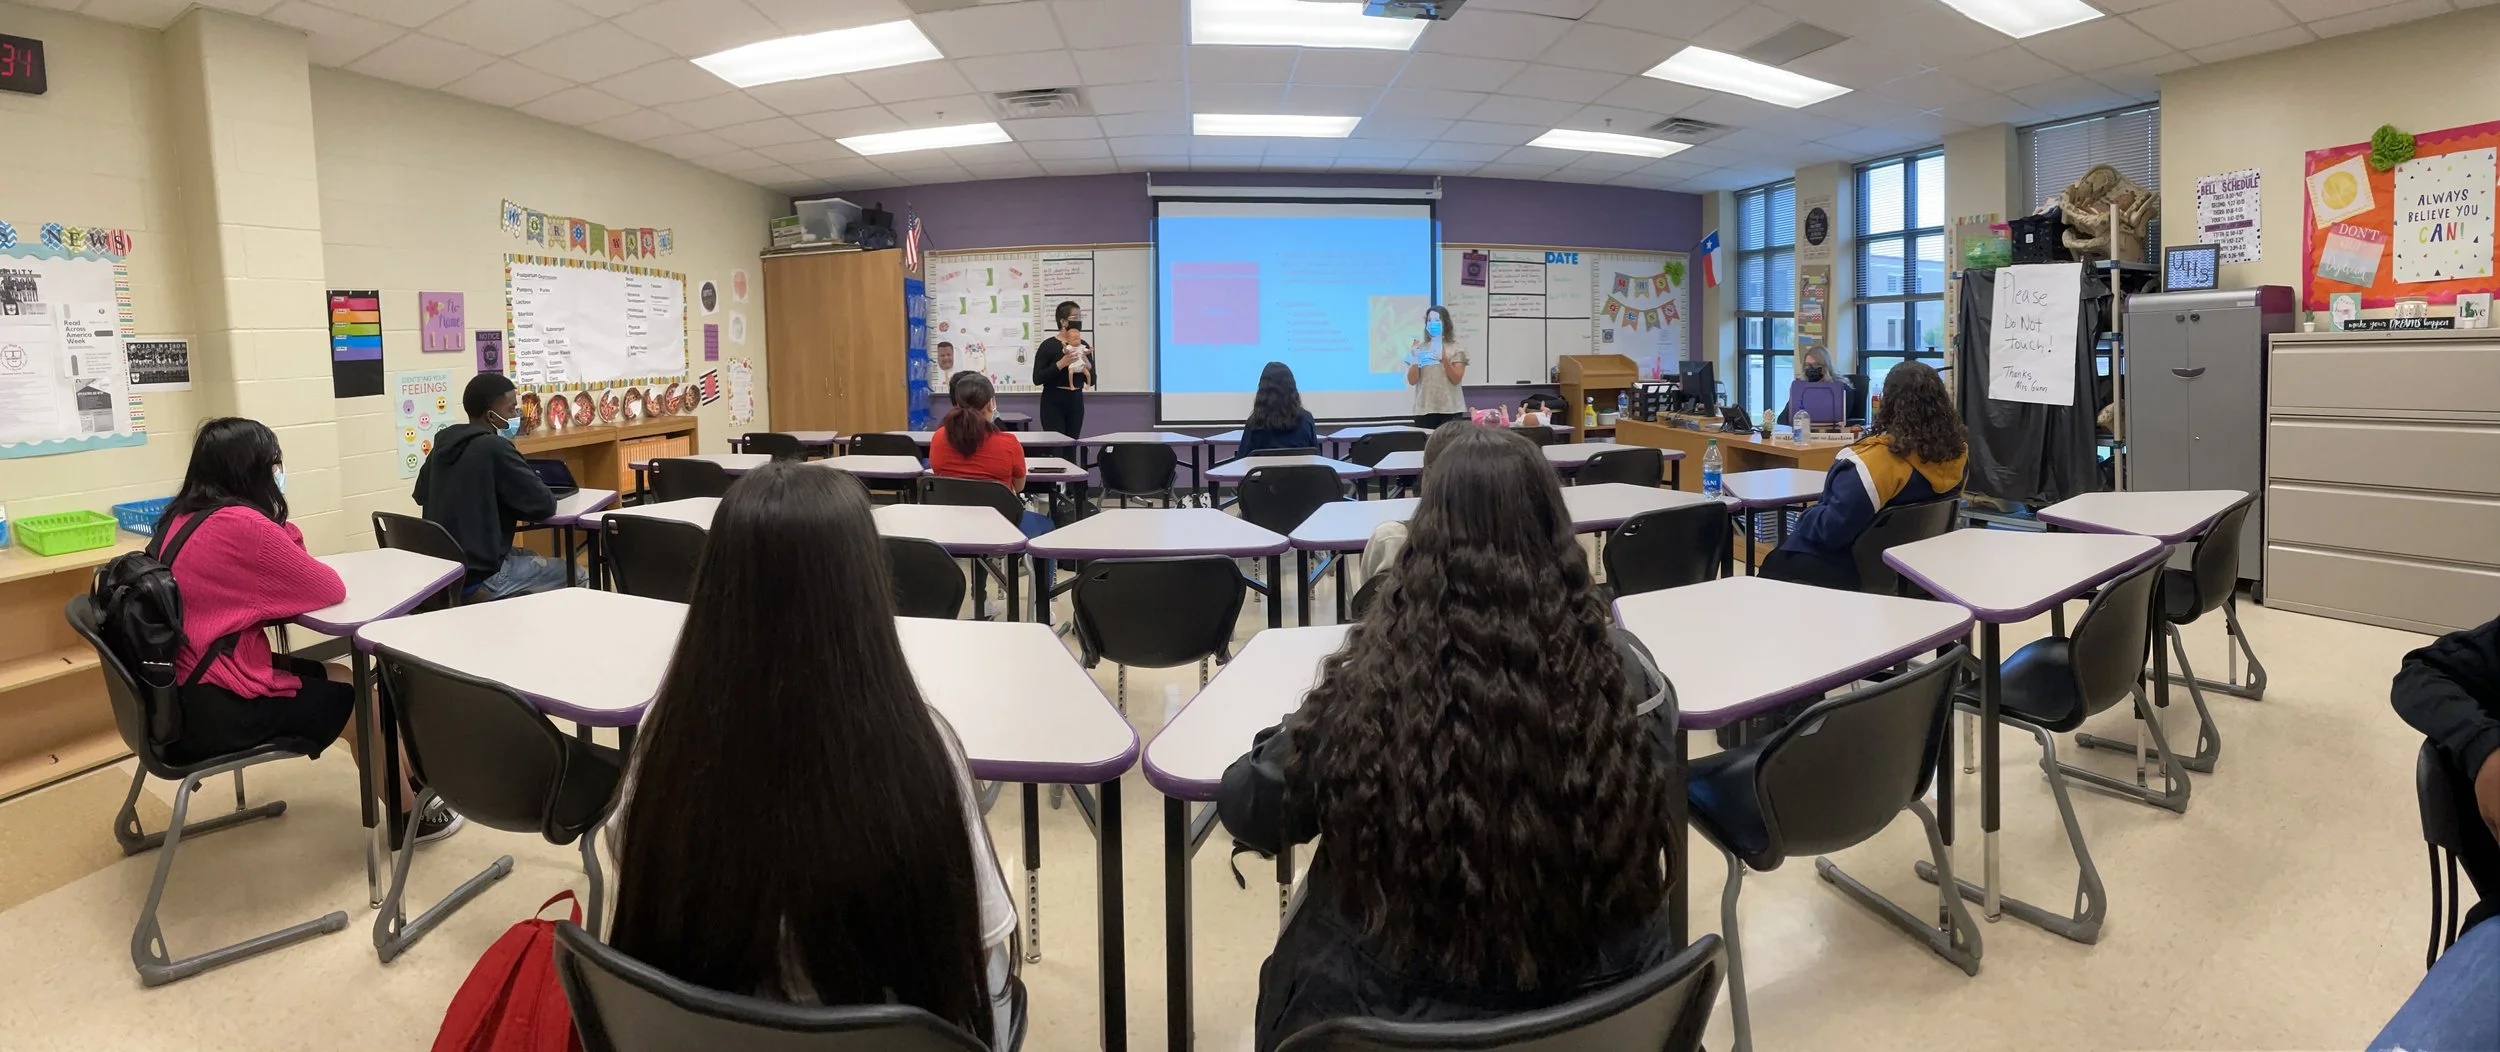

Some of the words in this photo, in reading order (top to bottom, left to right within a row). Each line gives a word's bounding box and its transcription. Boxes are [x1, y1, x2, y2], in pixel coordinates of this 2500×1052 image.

[2200, 184, 2216, 196] BELL
[2222, 177, 2260, 192] SCHEDULE
[2417, 188, 2469, 206] ALWAYS
[2408, 208, 2450, 223] BELIEVE
[2456, 204, 2478, 217] YOU
[47, 228, 126, 250] NEWS
[2338, 223, 2380, 241] DON'T
[2418, 222, 2465, 244] CAN!
[1546, 252, 1579, 265] DATE
[2172, 251, 2210, 284] UHS
[2003, 271, 2048, 307] Please
[2459, 305, 2487, 318] Lve
[2004, 313, 2017, 329] Do
[2020, 314, 2043, 332] Not
[2348, 319, 2367, 329] make
[2369, 321, 2387, 331] your
[2389, 318, 2421, 329] DREAMS
[2423, 318, 2449, 330] happen
[478, 332, 501, 340] NOTICE
[2003, 365, 2033, 381] Thanks
[401, 381, 448, 396] FEELINGS
